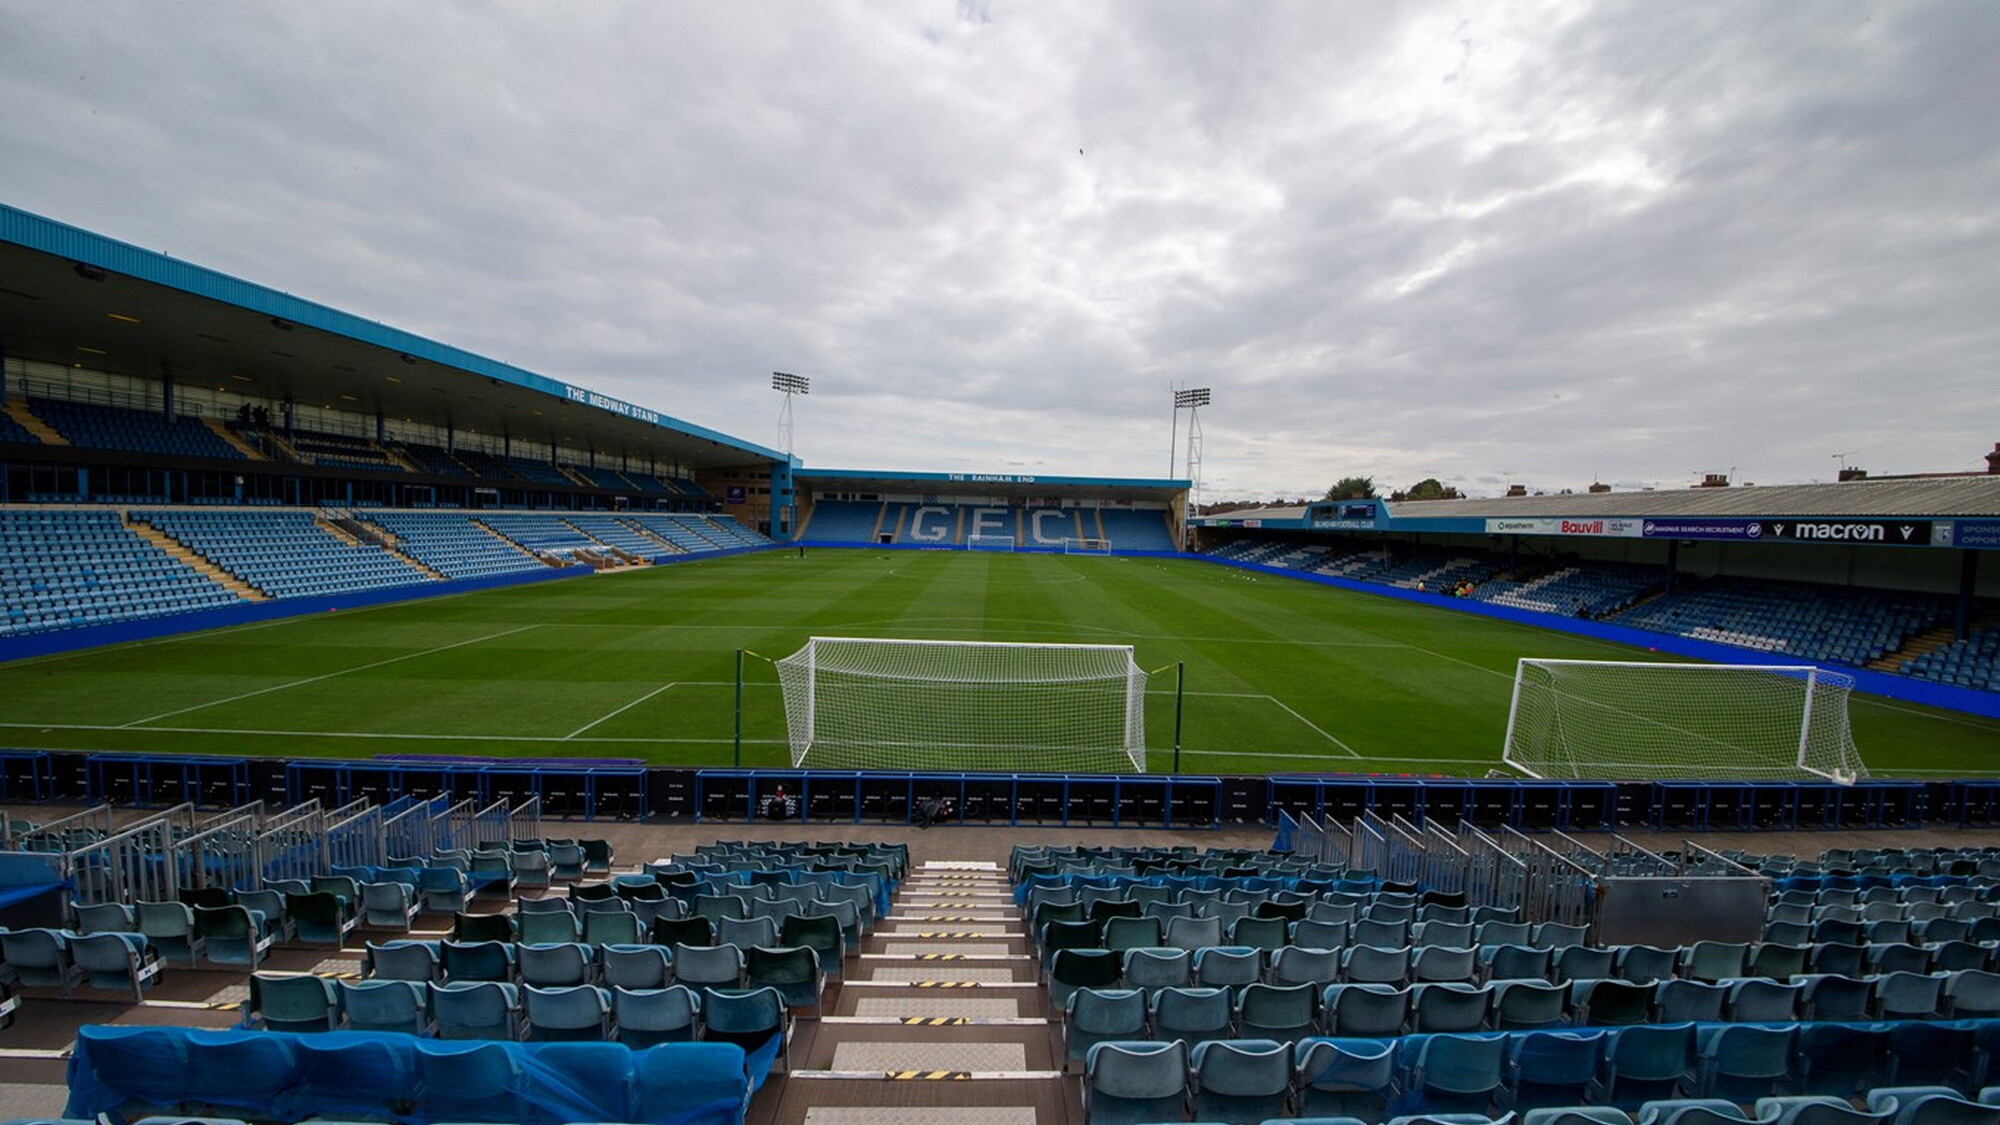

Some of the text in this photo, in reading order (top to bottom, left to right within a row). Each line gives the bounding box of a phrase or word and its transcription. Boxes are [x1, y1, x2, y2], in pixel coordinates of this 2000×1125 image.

[566, 386, 659, 423] THE MEDWAY STAND
[972, 474, 1012, 482] RAINHAM
[1018, 475, 1035, 483] END
[1795, 523, 1884, 540] macron
